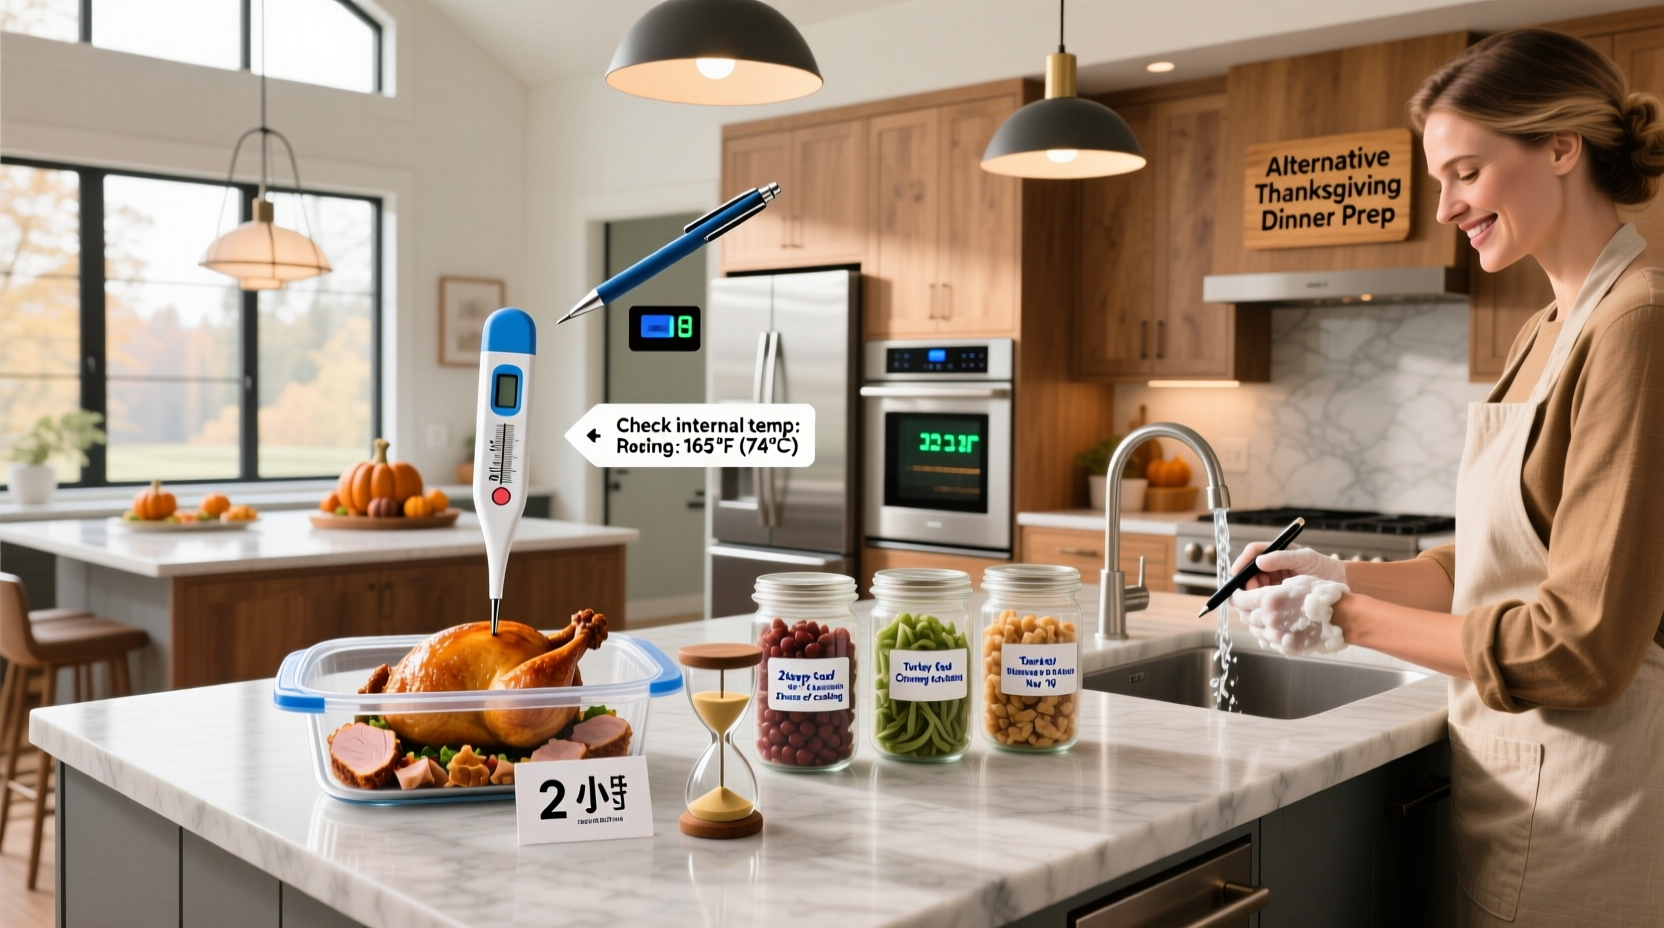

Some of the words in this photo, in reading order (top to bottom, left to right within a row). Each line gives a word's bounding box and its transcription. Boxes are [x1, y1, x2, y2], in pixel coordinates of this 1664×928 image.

[1266, 146, 1390, 178] Alternative
[1255, 174, 1401, 204] Thanksgiving
[1261, 208, 1336, 231] Dinner
[1342, 204, 1396, 229] Prep
[539, 779, 567, 820] 2
